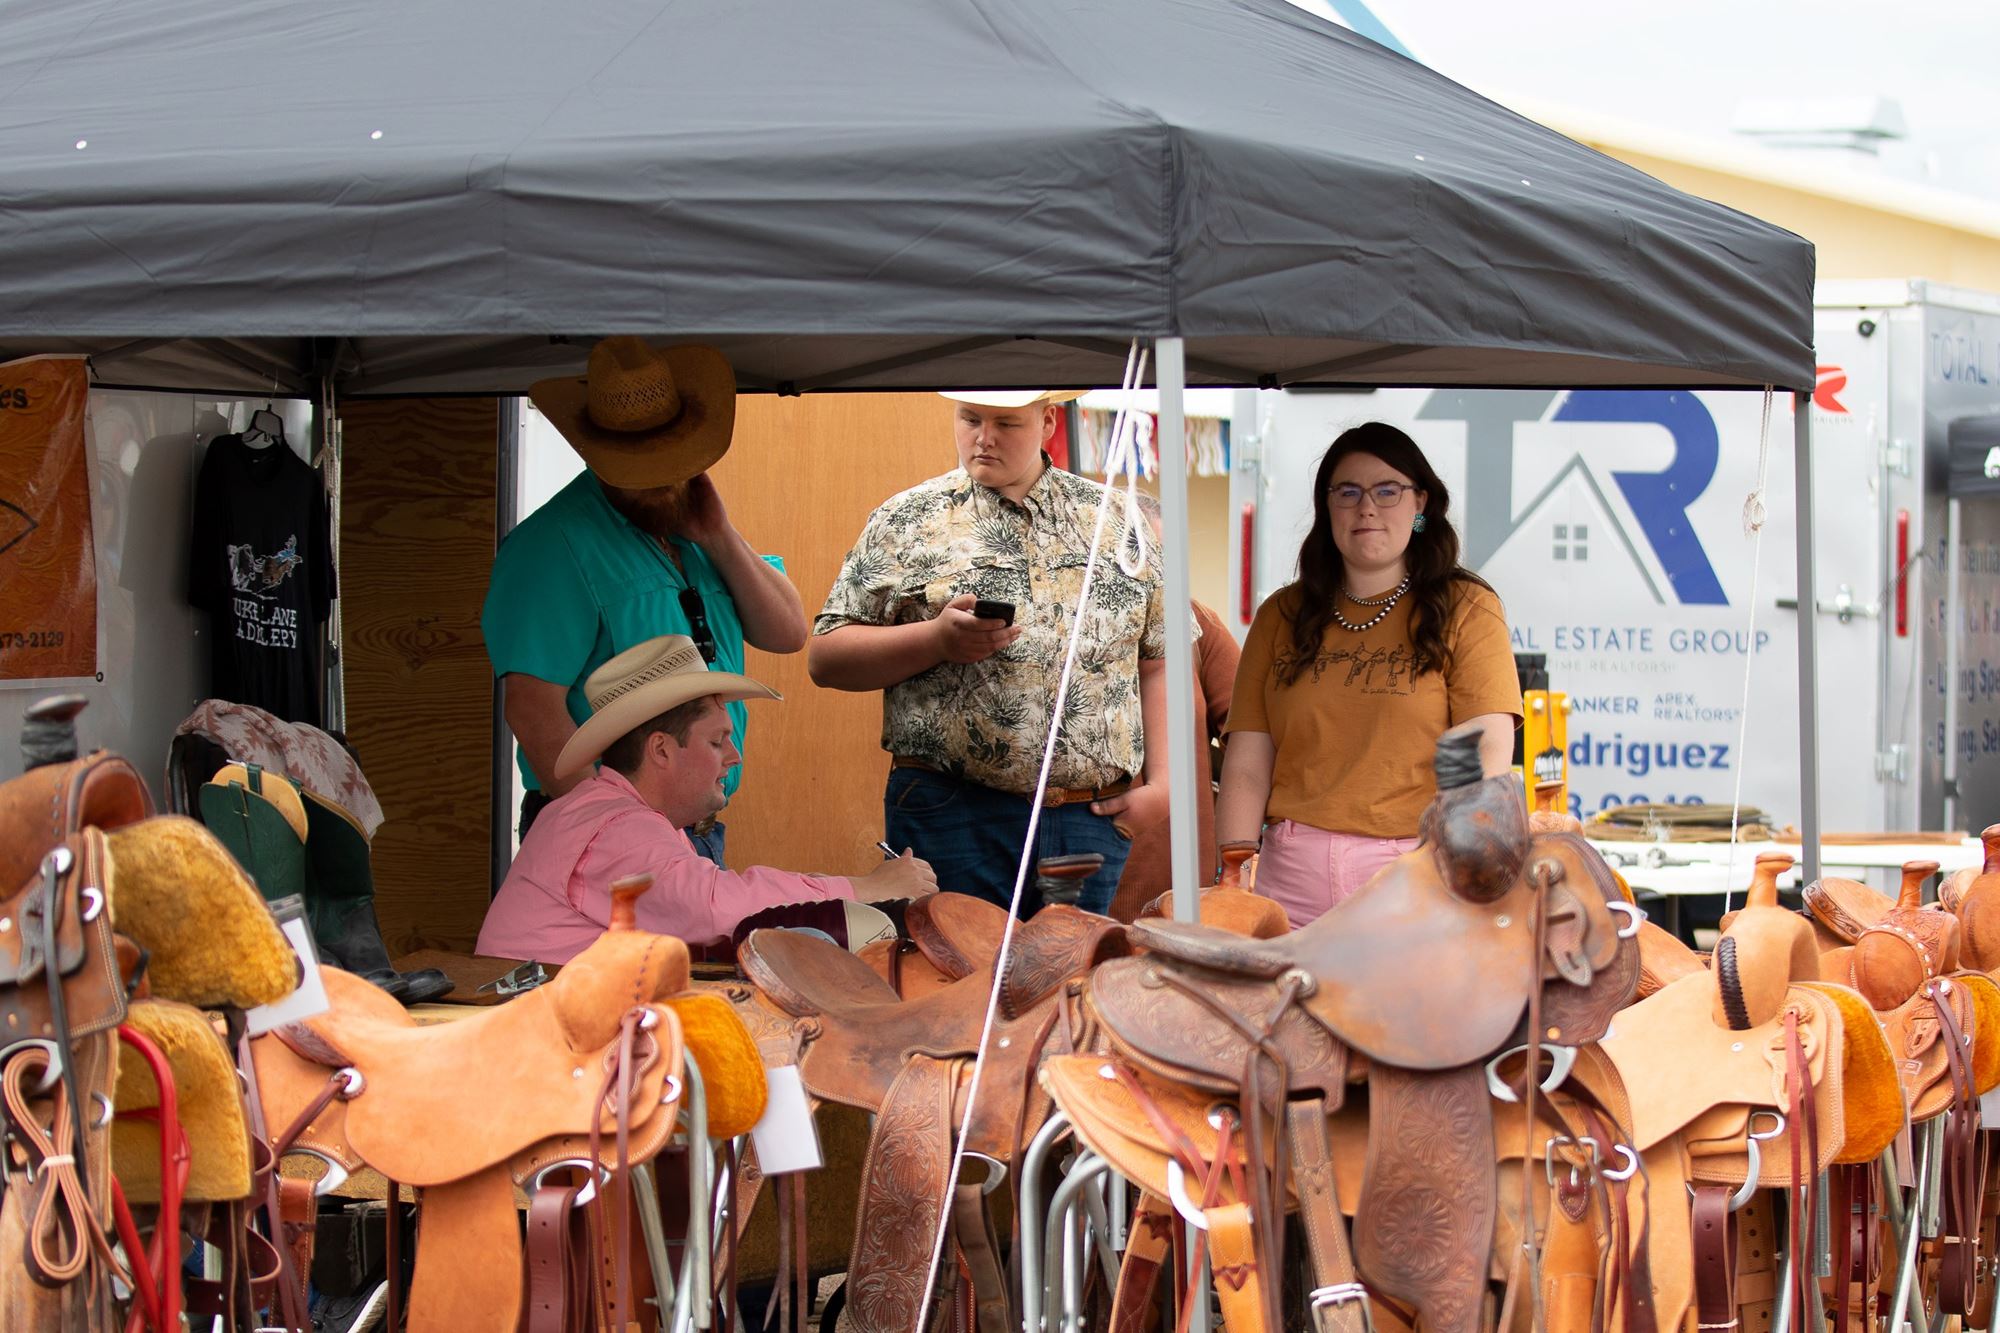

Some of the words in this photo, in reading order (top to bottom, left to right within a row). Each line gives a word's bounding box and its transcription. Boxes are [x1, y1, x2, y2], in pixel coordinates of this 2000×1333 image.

[1930, 332, 1988, 386] TOTAL
[0, 384, 28, 409] es
[0, 631, 65, 649] 73-2129
[1510, 625, 1540, 650] AL
[1554, 625, 1654, 652] ESTATE
[1669, 628, 1770, 654] GROUP
[1571, 695, 1639, 715] ANKER
[1653, 692, 1696, 706] APEX
[1568, 731, 1731, 778] driguez
